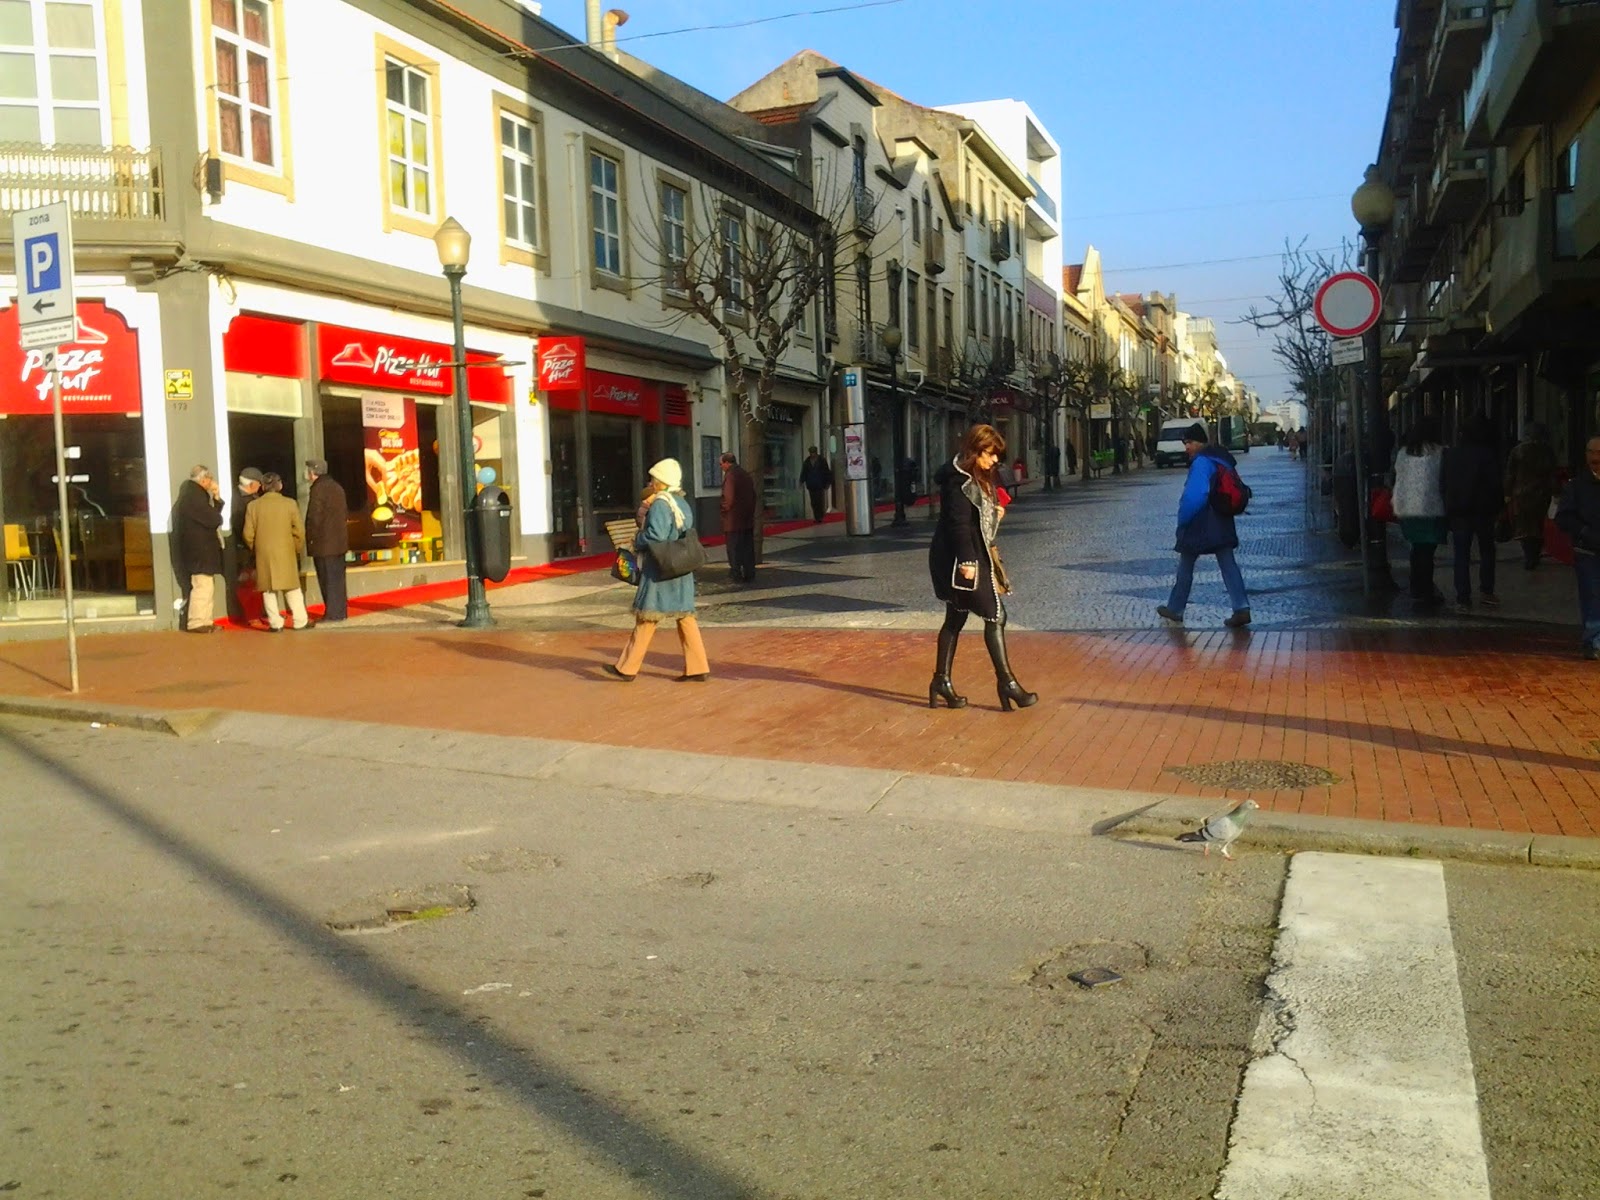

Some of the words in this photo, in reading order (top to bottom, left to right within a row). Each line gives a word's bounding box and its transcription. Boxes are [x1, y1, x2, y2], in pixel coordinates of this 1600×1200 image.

[29, 213, 50, 226] zona
[31, 242, 54, 288] P
[542, 357, 575, 375] Pizza
[548, 368, 574, 383] Hut
